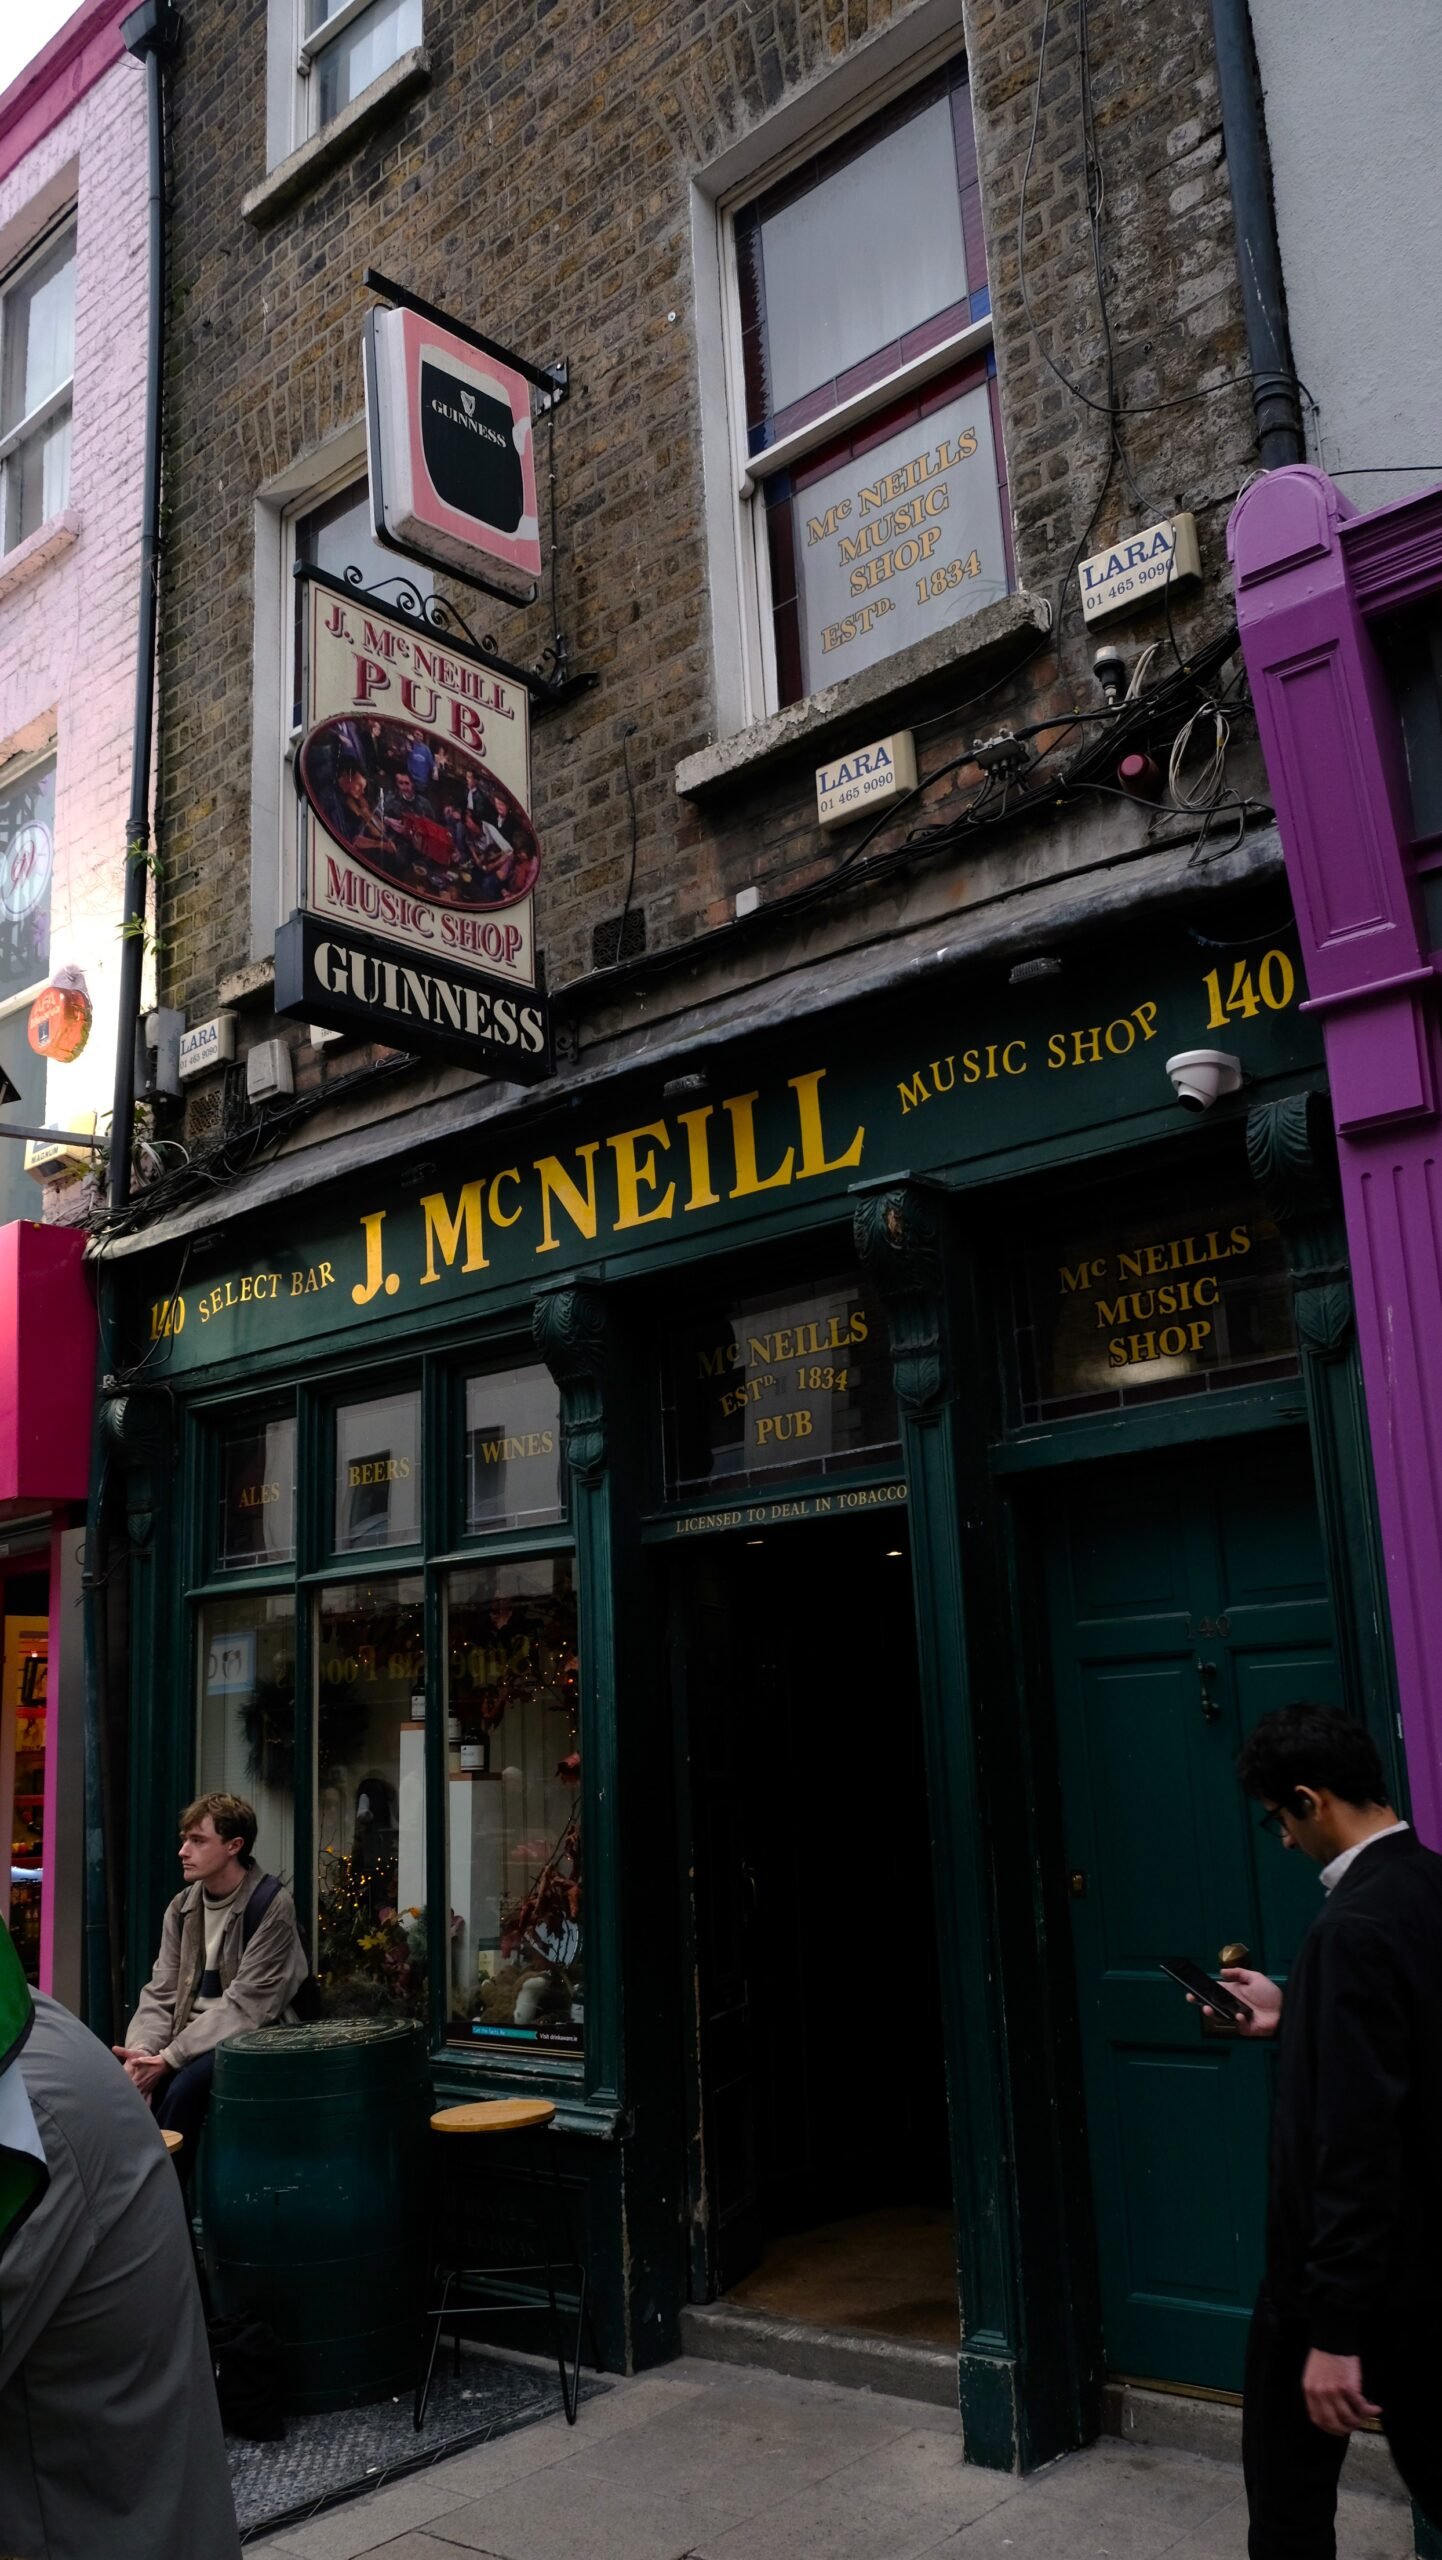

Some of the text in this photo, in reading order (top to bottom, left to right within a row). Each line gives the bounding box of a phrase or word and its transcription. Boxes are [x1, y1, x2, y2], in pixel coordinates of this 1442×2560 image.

[431, 399, 507, 448] GUINNESS
[838, 482, 949, 567] MUSIC
[850, 526, 942, 598] SHOP
[916, 549, 982, 605] 1834
[1083, 531, 1173, 591] LARA
[1086, 558, 1175, 610] 01 465 9090
[325, 604, 354, 645] J.
[352, 652, 487, 758] PUB
[818, 745, 893, 795] LARA
[820, 771, 894, 812] 01 465 9090
[325, 855, 522, 968] MUSIC SHOP
[314, 942, 545, 1053] GUINNESS
[1202, 949, 1295, 1030] 140
[181, 1024, 217, 1056] LARA
[896, 1001, 1158, 1115] MUSIC SHOP
[31, 1146, 59, 1163] MAGNUM
[351, 1210, 400, 1305] J.
[149, 1260, 336, 1341] 140 SELECT BAR
[1094, 1276, 1220, 1328] MUSIC
[1109, 1320, 1212, 1368] SHOP
[796, 1366, 849, 1392] 1834
[482, 1430, 553, 1465] WINES
[755, 1410, 813, 1446] PUB
[239, 1482, 281, 1508] ALES
[349, 1457, 410, 1488] BEERS
[676, 1484, 908, 1534] LICENSED TO DEAL IN TOBACCO
